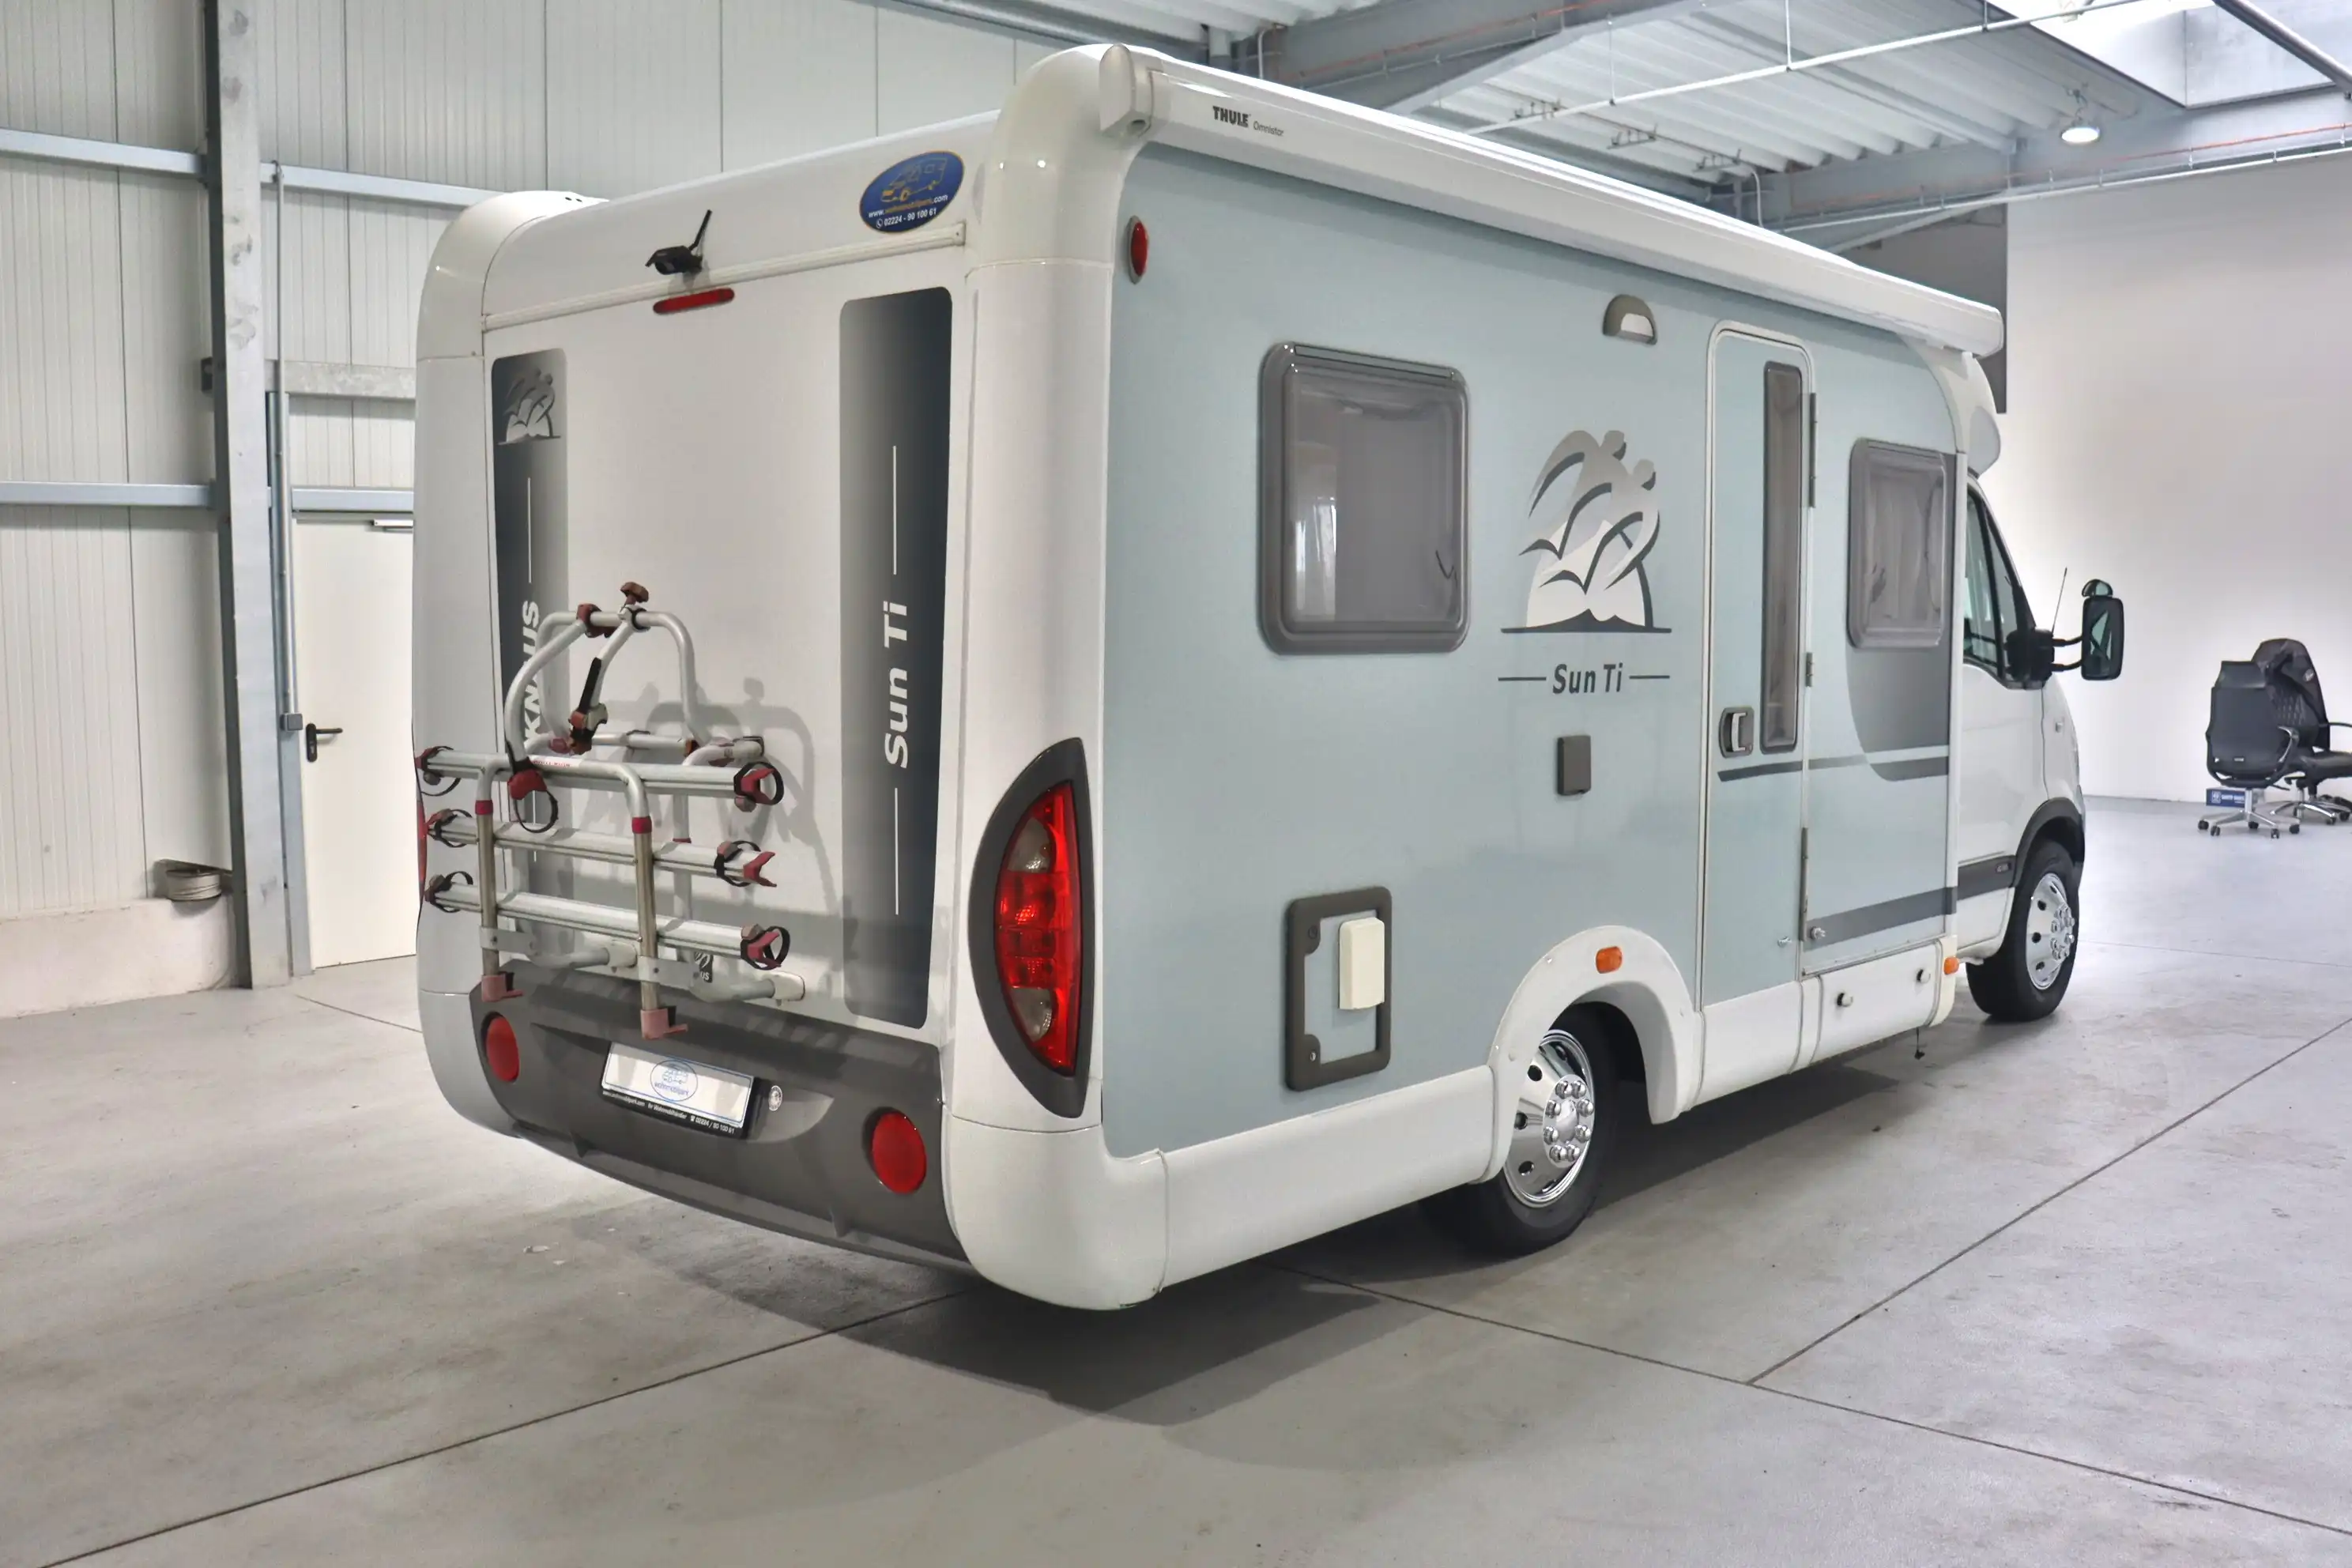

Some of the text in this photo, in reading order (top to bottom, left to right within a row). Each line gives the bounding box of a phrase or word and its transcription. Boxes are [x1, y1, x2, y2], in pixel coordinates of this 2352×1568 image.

[1212, 105, 1249, 128] THULE
[884, 215, 903, 227] 02224
[917, 209, 929, 219] 100
[929, 207, 937, 217] 61
[522, 600, 541, 742] KNUS
[883, 601, 908, 769] Sun Ti
[1552, 662, 1623, 694] Sun Ti
